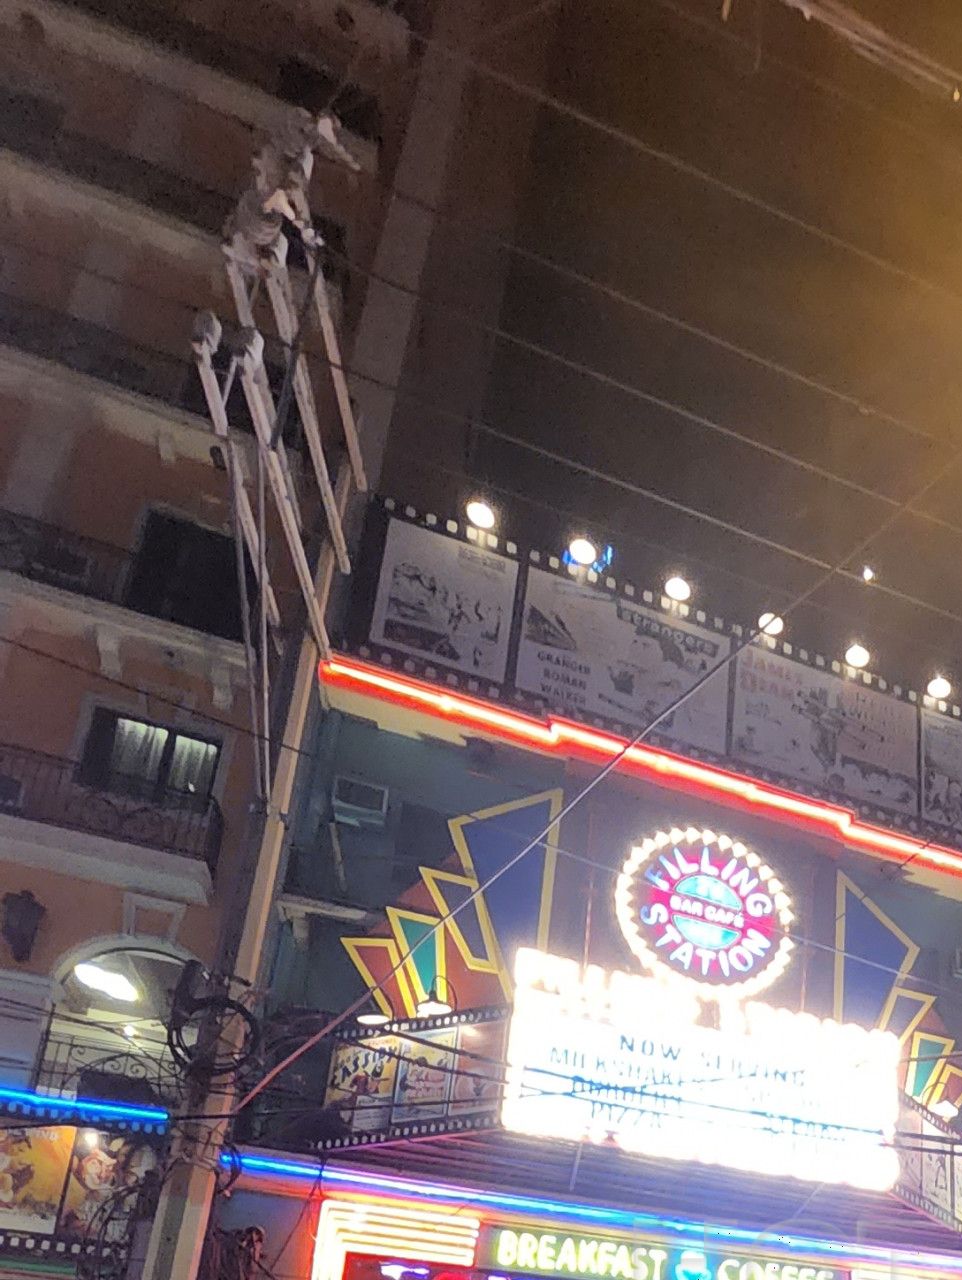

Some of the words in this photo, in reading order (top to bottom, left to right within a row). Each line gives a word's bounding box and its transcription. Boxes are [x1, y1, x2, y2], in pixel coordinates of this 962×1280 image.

[644, 846, 773, 918] FILLING
[640, 902, 773, 978] STATION
[619, 1034, 682, 1061] NOW
